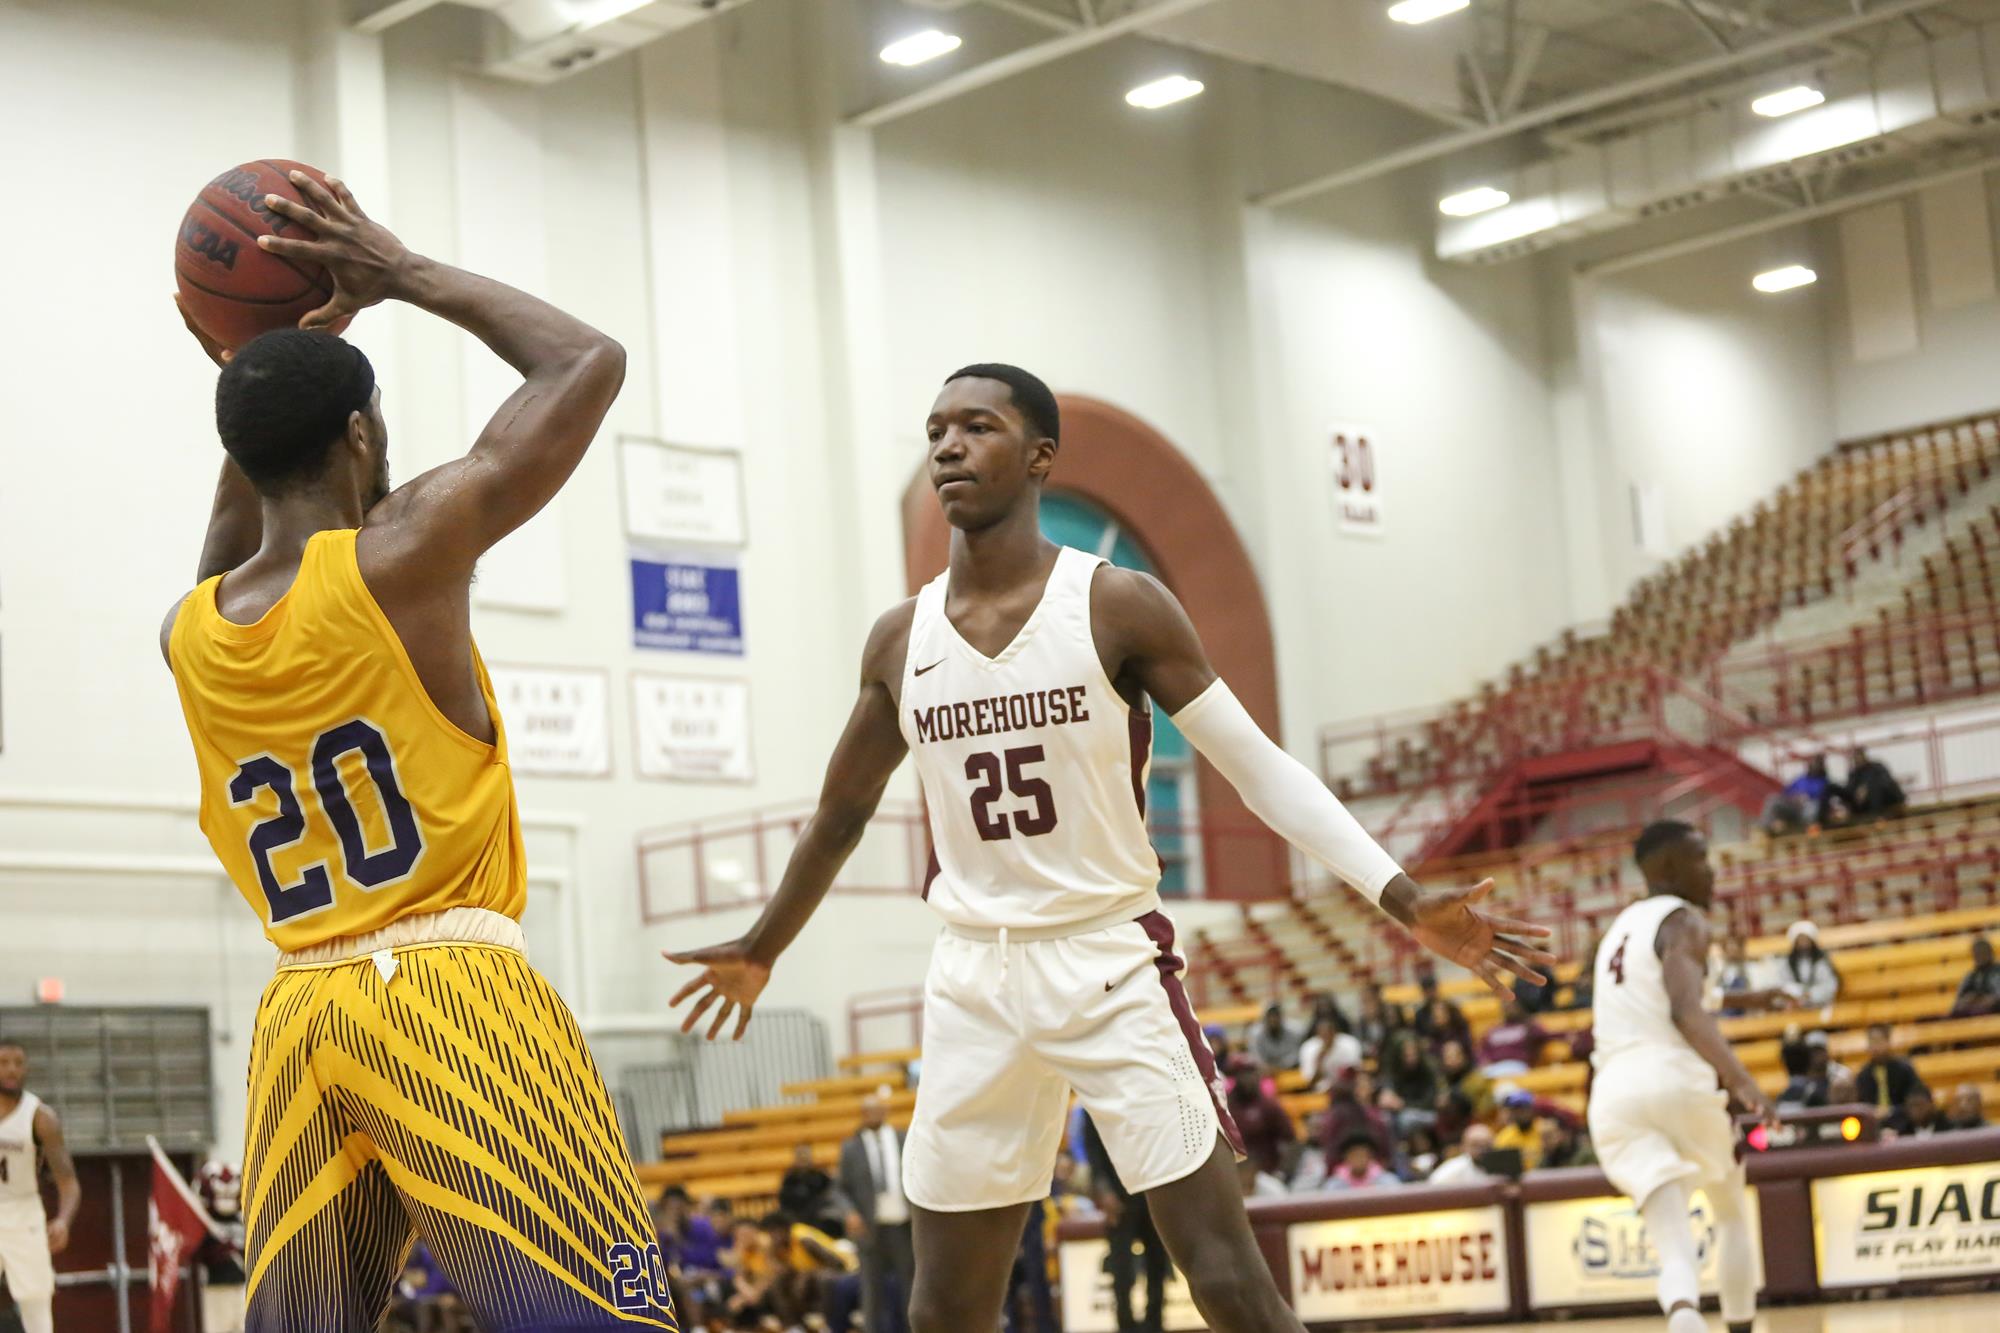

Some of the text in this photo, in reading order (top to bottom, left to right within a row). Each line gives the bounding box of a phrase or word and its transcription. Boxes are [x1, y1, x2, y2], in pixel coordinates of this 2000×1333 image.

[914, 685, 1089, 743] MOREHOUSE
[227, 716, 427, 928] 20
[964, 744, 1058, 841] 25
[1608, 934, 1629, 985] 4
[607, 1242, 671, 1309] 20
[1302, 1232, 1496, 1292] MOREHOUSE
